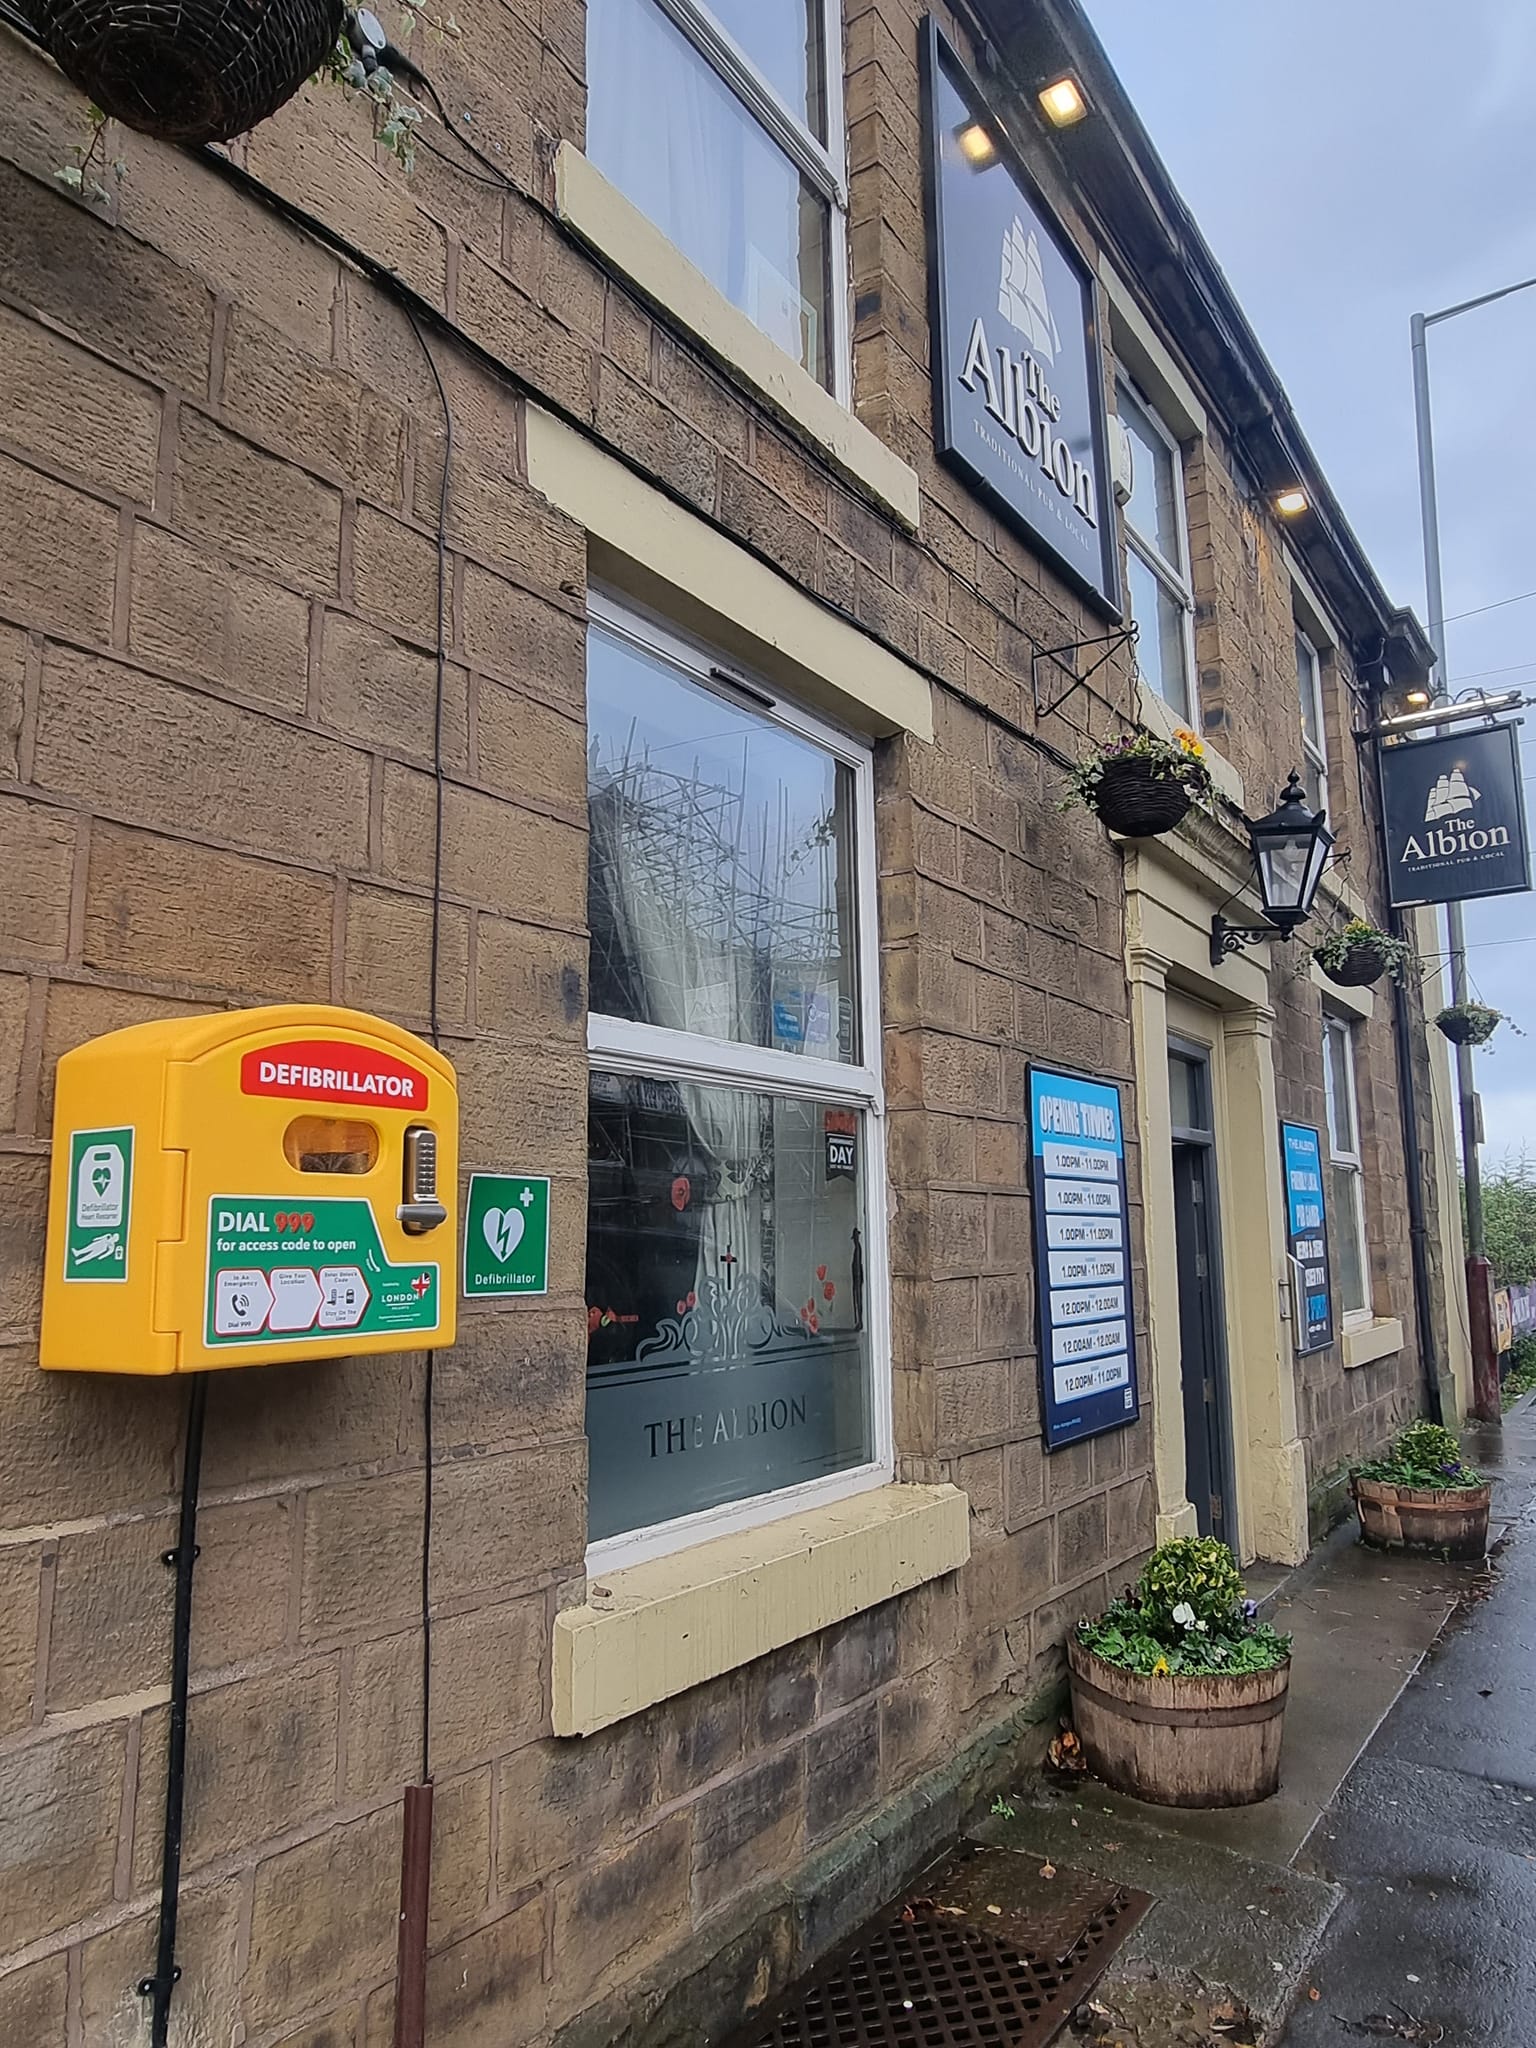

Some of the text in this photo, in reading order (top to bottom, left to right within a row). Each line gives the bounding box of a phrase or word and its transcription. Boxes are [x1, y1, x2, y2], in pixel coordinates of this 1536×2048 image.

[1021, 350, 1061, 423] The
[957, 317, 1098, 529] Albion
[973, 418, 1036, 493] TRADITIONAL
[1444, 818, 1475, 833] The
[1400, 825, 1512, 863] Albion
[1408, 860, 1454, 873] TRADITIONAL
[260, 1061, 414, 1098] DEFIBRILLATOR
[1040, 1095, 1080, 1137] OPENING
[829, 1145, 854, 1165] DAY
[81, 1203, 118, 1213] Defibrillator
[218, 1211, 316, 1233] DIAL 999
[216, 1238, 356, 1253] for access code to open
[475, 1273, 536, 1285] Defibrillator
[381, 1293, 419, 1303] LONDON
[644, 1394, 806, 1458] THE ALBION
